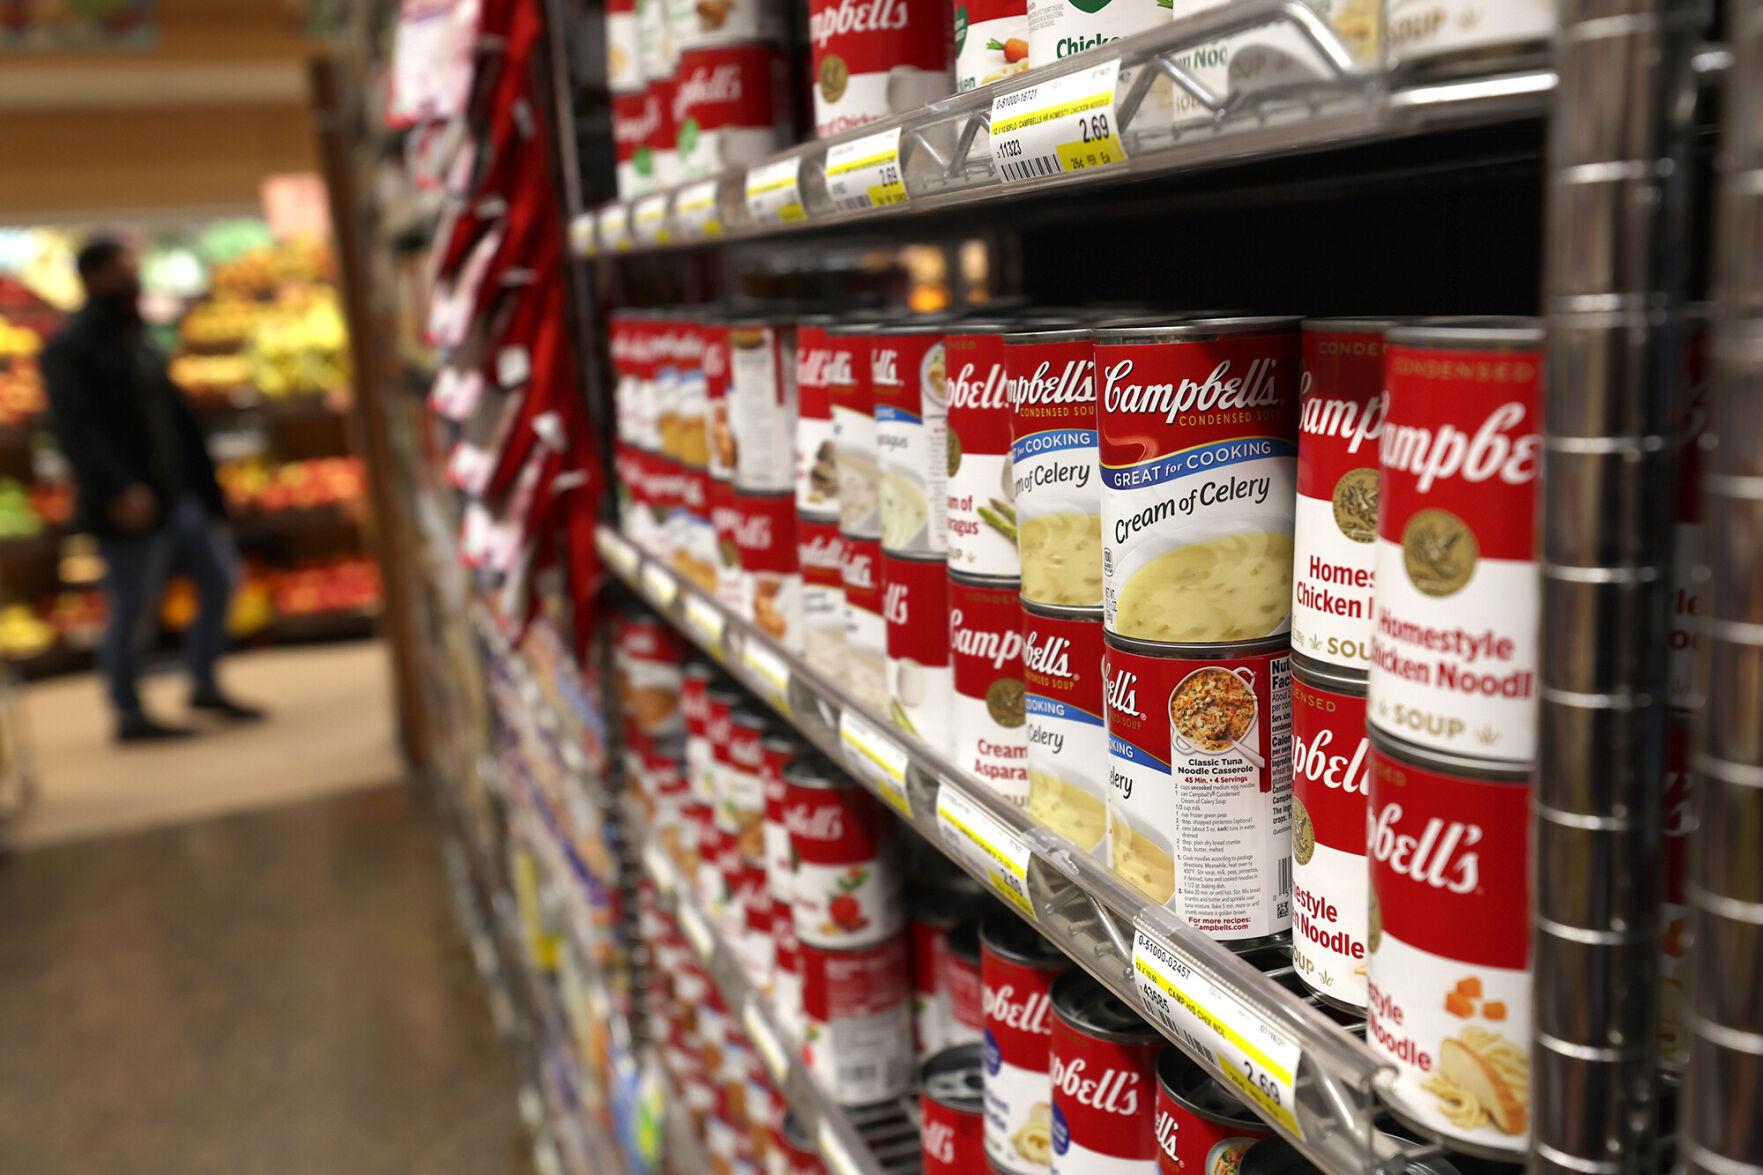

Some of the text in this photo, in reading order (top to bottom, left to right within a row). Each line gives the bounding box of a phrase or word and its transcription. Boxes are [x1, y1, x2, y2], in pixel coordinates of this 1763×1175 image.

[997, 89, 1038, 110] 0-51000-16721
[1019, 117, 1042, 128] CAMPBELLS
[1079, 114, 1109, 143] 2.69
[1000, 139, 1022, 158] 11323
[1104, 359, 1279, 424] Campbell's
[1020, 408, 1069, 417] CONDENSED
[1179, 412, 1251, 427] CONDENSED
[1026, 433, 1091, 453] COOKING
[1034, 462, 1090, 488] Celery
[1114, 441, 1271, 487] GREAT for COOKING
[1115, 476, 1270, 544] Cream of Celery
[1297, 581, 1362, 619] Chicken
[1379, 606, 1515, 663] Homestyle
[1052, 680, 1075, 690] SOUP
[1122, 717, 1142, 730] SOUP
[1394, 703, 1465, 739] SOUP
[978, 739, 1028, 759] Cream
[975, 758, 1028, 780] Aspara
[1178, 766, 1254, 775] Noodle Casserole
[1222, 758, 1243, 766] Tuna
[1301, 912, 1365, 959] Noodle
[1139, 935, 1191, 980] 0-51000-02457
[1144, 983, 1170, 1014] 43685
[1168, 987, 1186, 1005] CAMP
[1244, 1061, 1281, 1105] 2.69
